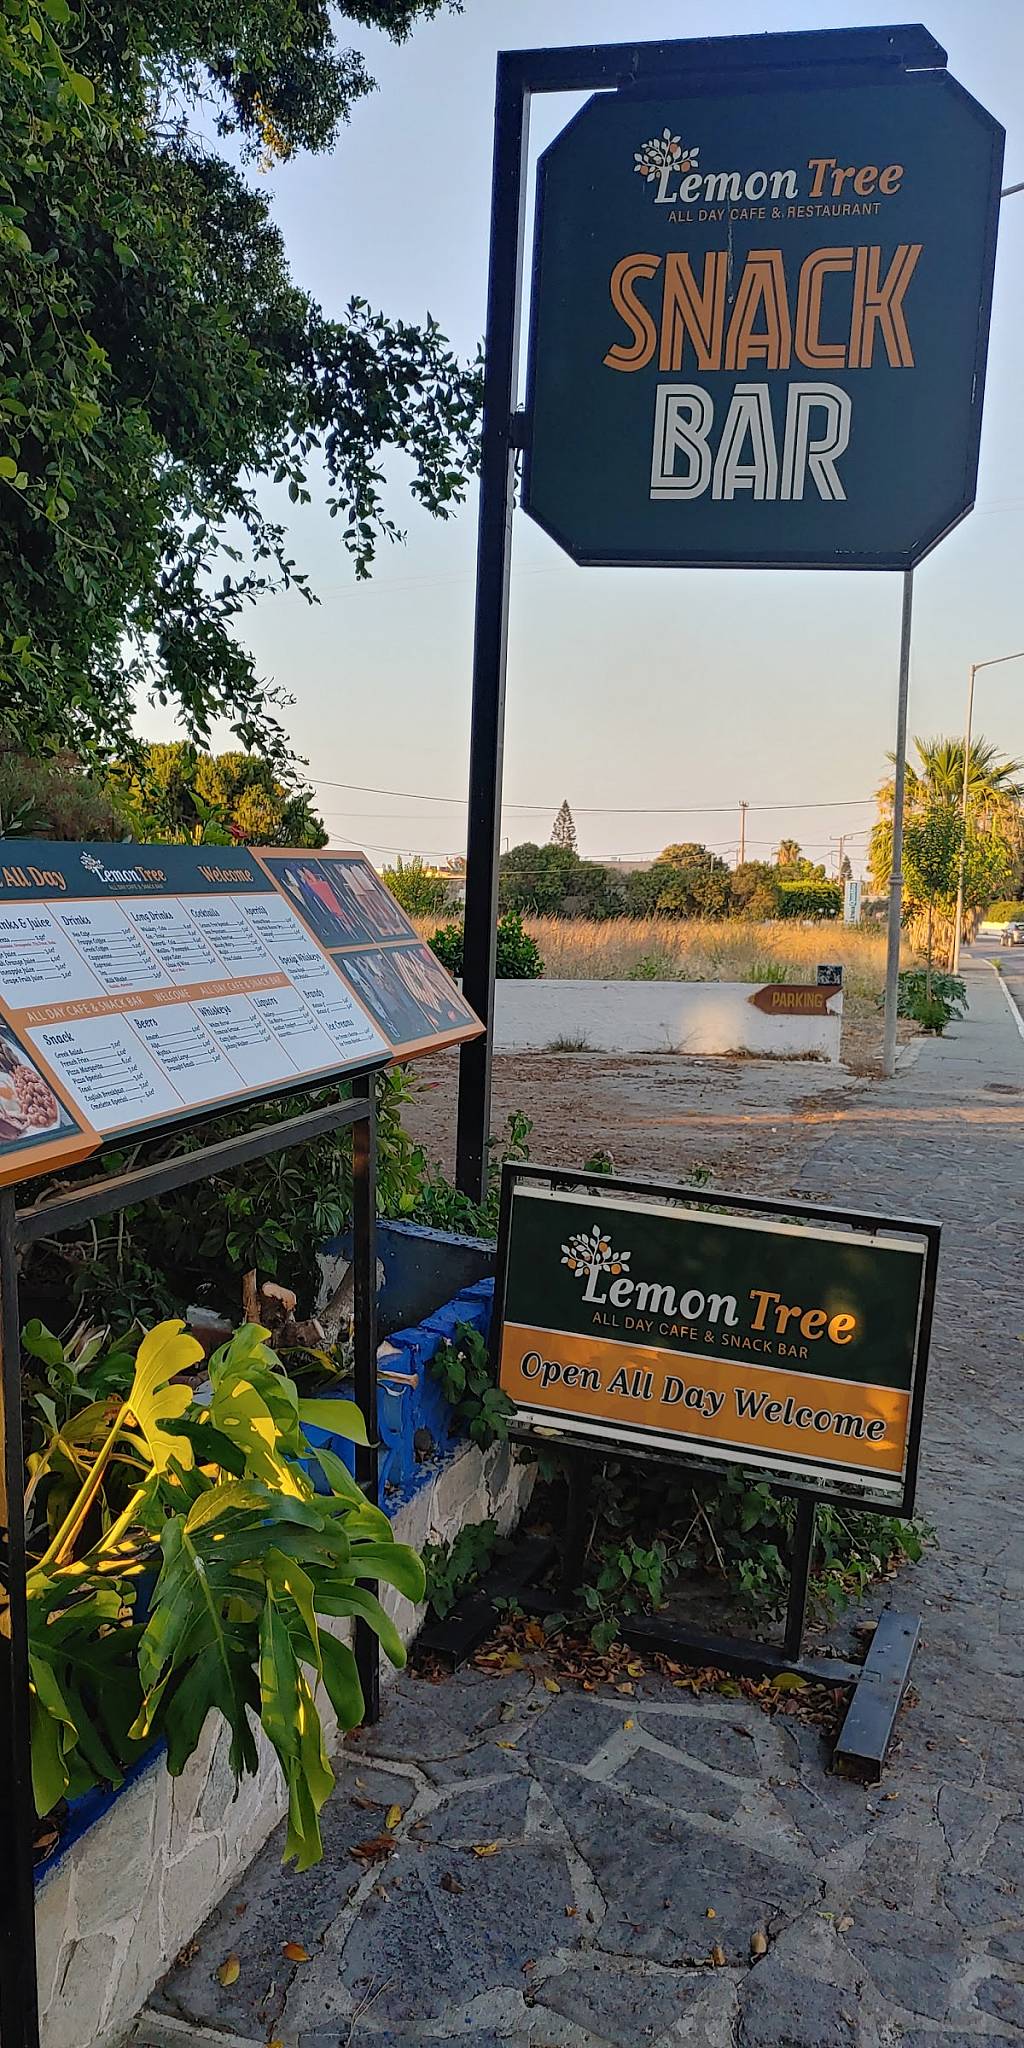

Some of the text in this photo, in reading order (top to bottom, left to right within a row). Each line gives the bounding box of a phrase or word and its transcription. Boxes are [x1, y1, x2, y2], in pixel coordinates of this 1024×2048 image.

[654, 158, 904, 203] Lemon Tree
[668, 202, 882, 222] ALL DAY CAFE & RESTAURANT
[602, 244, 924, 373] SNACK
[650, 382, 852, 500] BAR
[2, 866, 67, 891] All Day
[92, 866, 167, 882] Lemon Tree
[198, 865, 254, 883] Welcome
[26, 917, 51, 931] Juice
[61, 914, 91, 926] Drinks
[130, 910, 174, 923] Long Drinks
[26, 1011, 47, 1023] ALL
[45, 1007, 66, 1019] DAY
[65, 1003, 91, 1016] CAFE
[91, 1002, 99, 1012] &
[99, 999, 125, 1011] SNACK
[126, 996, 145, 1007] BAR
[153, 988, 191, 1002] WELCOME
[771, 991, 824, 1008] PARKING
[197, 1004, 232, 1017] Whiskeys
[134, 1018, 158, 1029] Beers
[43, 1031, 75, 1046] Snack
[60, 1060, 77, 1069] French
[66, 1068, 80, 1077] Pizza
[72, 1076, 86, 1085] Pizza
[581, 1264, 856, 1345] Lemon Tree
[592, 1311, 809, 1360] ALL DAY CAFE & SNACK BAR
[520, 1350, 888, 1442] Open All Day Welcome
